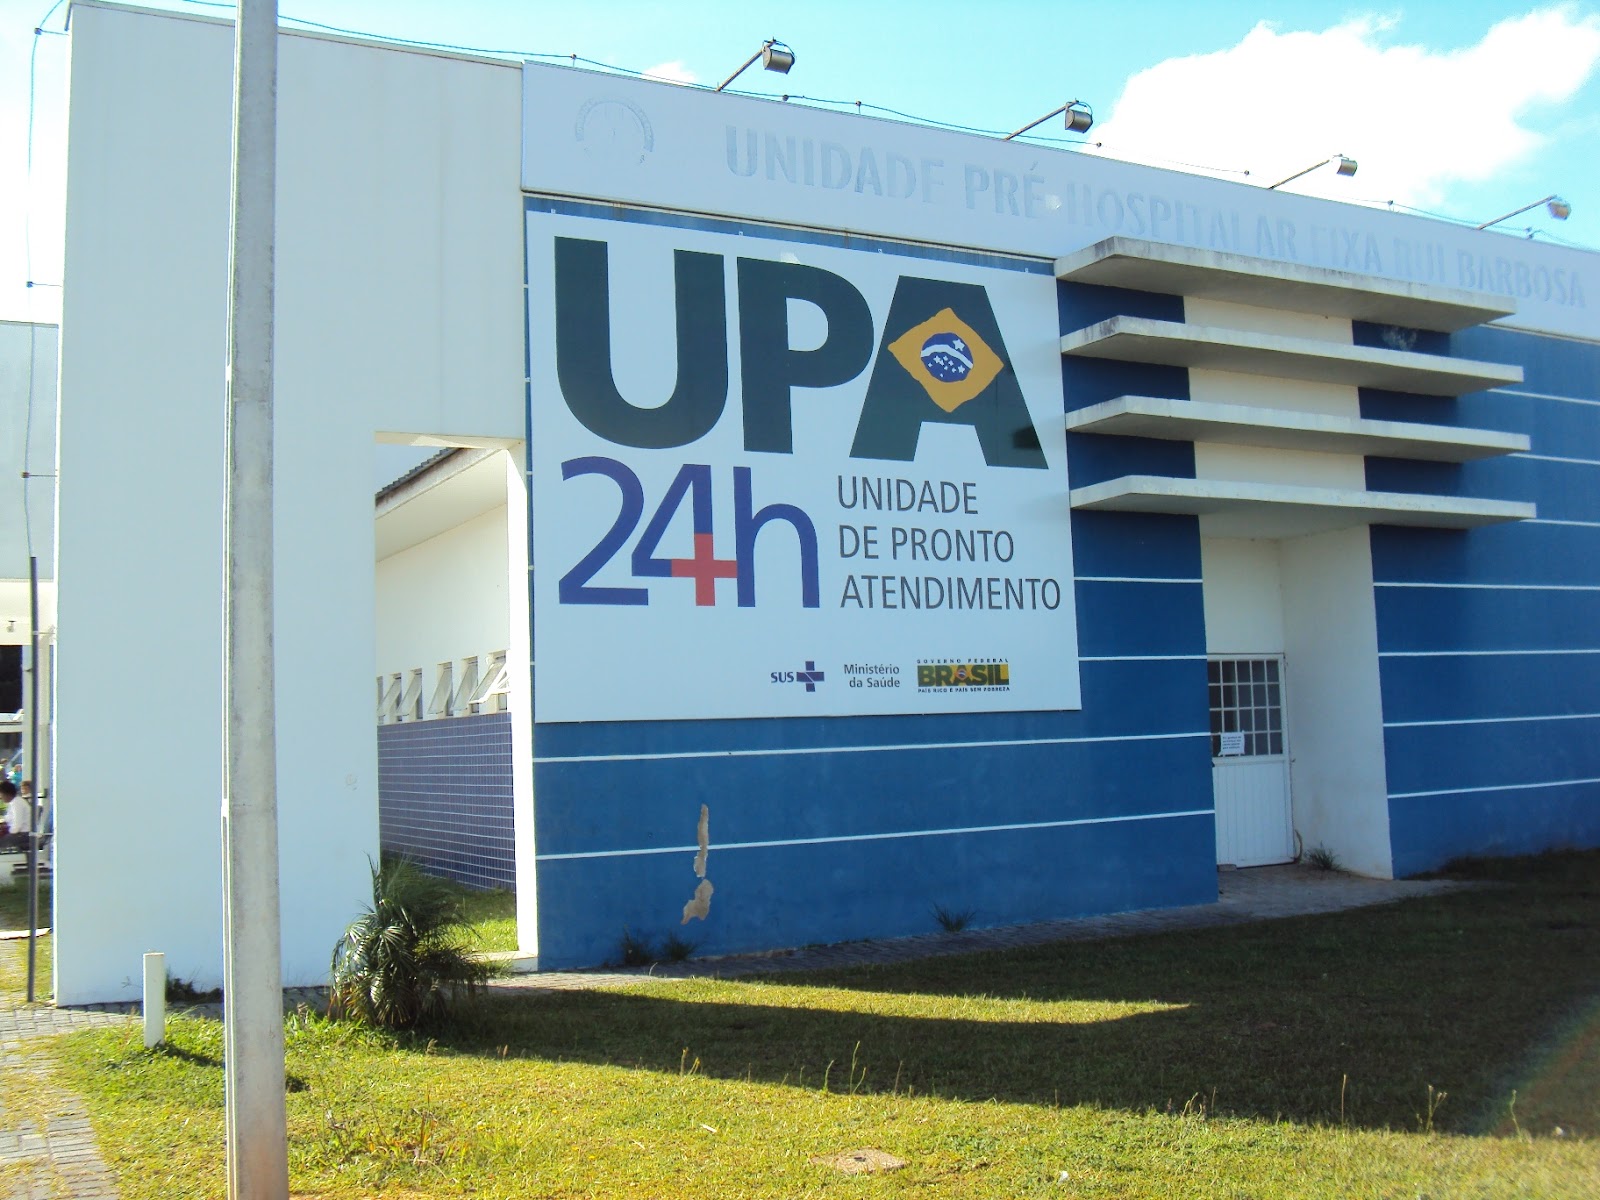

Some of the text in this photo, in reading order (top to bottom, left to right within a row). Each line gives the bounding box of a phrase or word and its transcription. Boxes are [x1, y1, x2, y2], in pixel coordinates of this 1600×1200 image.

[725, 125, 944, 203] UNIDADE
[1457, 249, 1586, 310] BARBOSA
[554, 235, 1048, 469] UPA
[838, 475, 978, 514] UNIDADE
[558, 456, 820, 608] 24h
[839, 524, 1014, 562] DE PRONTO
[840, 574, 1061, 610] ATENDIMENTO
[770, 671, 795, 683] SUS
[844, 663, 900, 675] Ministério
[849, 676, 901, 688] da Saúde
[917, 664, 1010, 687] BRASIL
